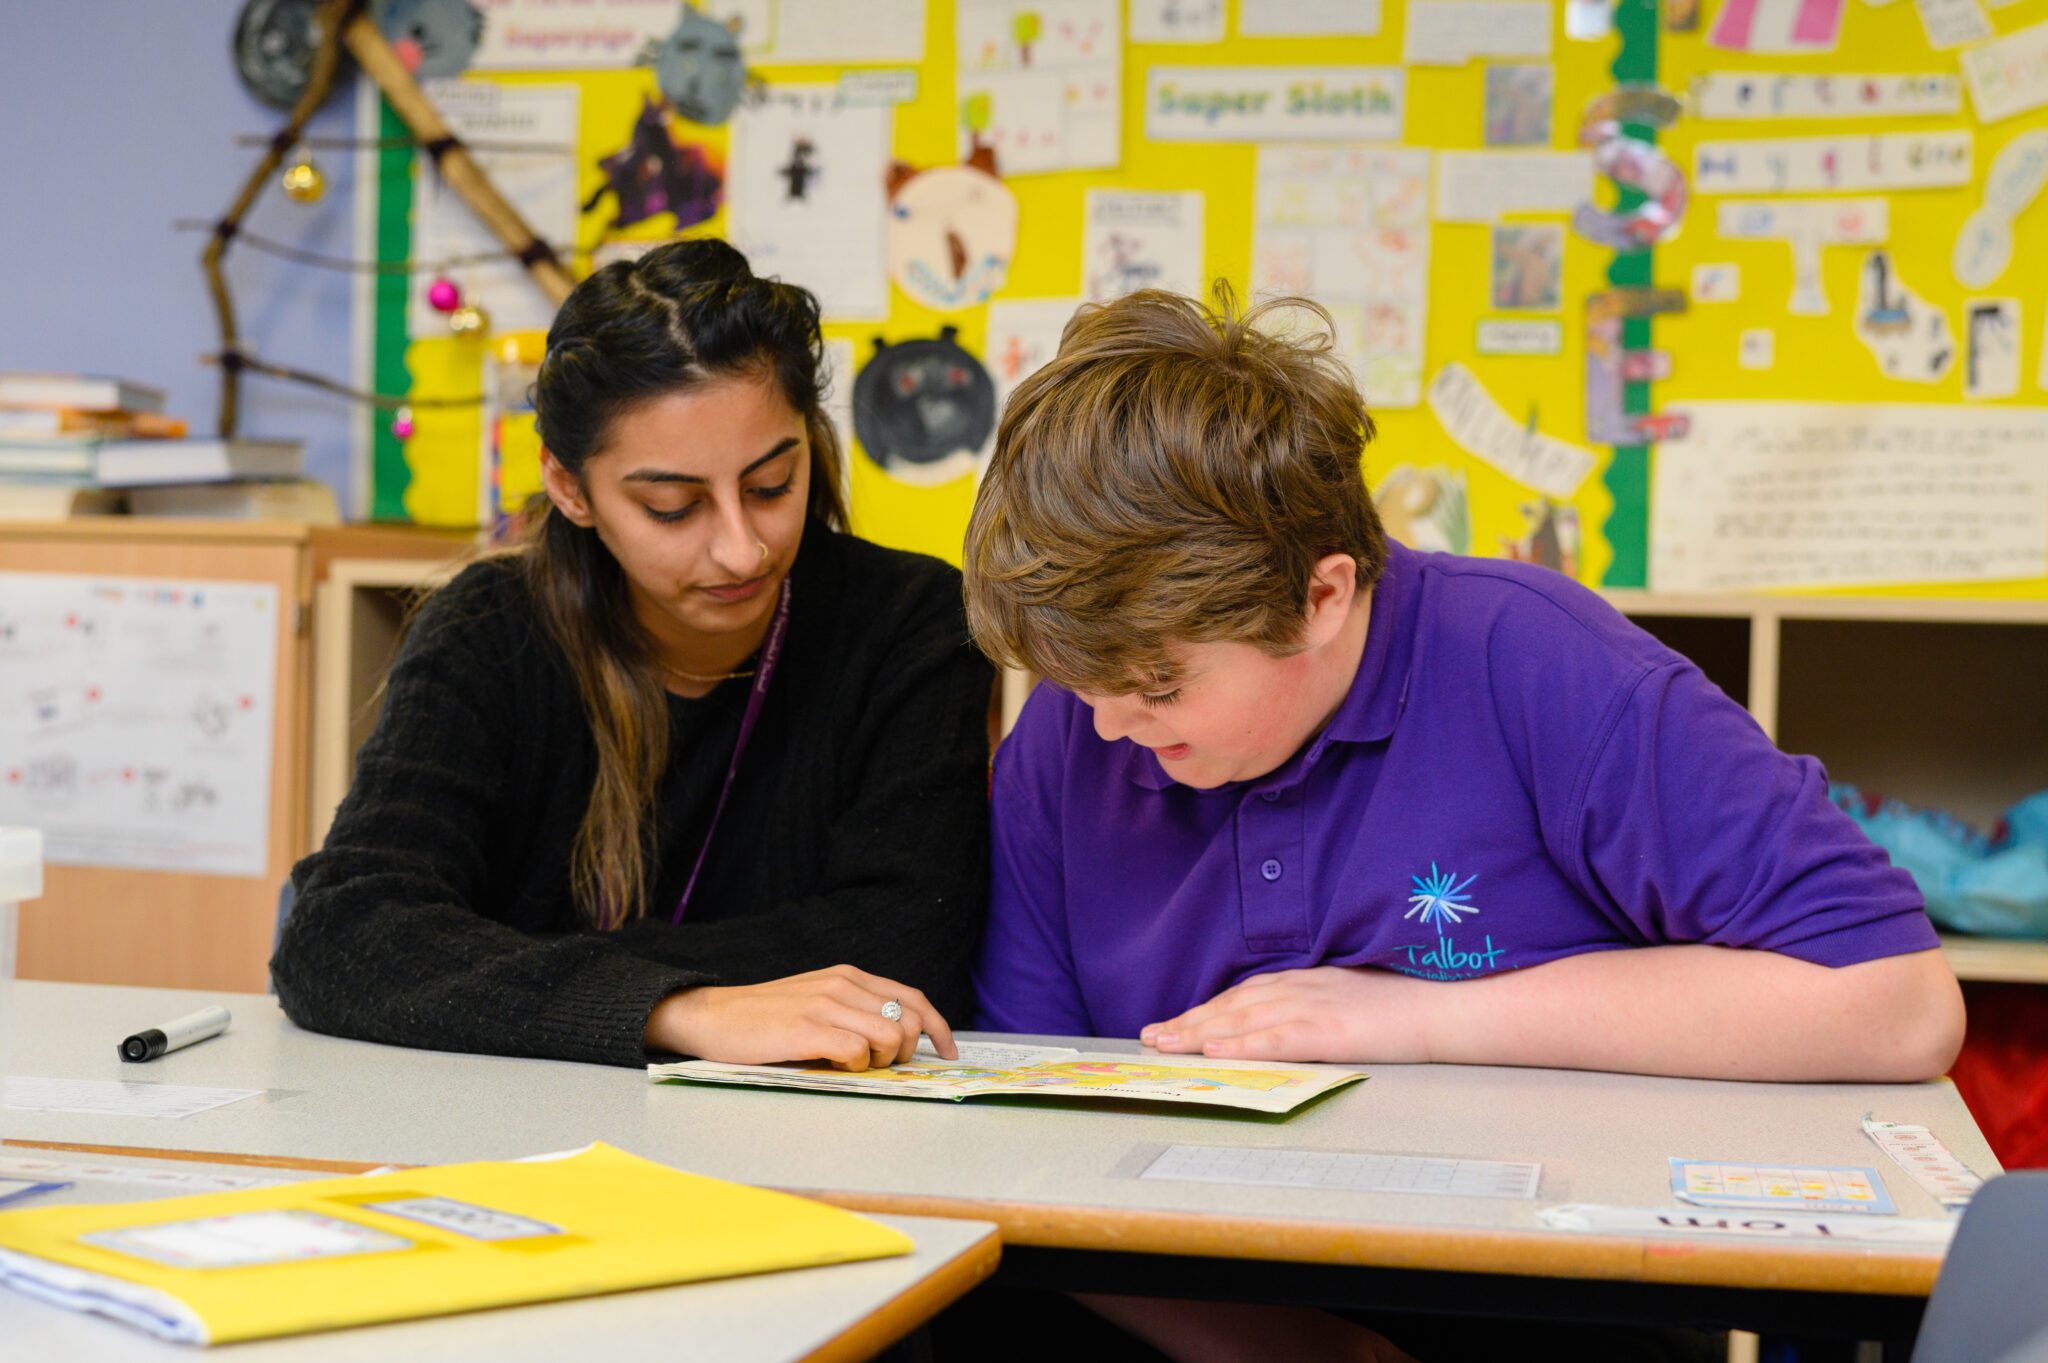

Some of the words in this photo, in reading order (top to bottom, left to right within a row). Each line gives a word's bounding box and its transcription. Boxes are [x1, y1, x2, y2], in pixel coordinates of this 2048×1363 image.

[1157, 81, 1268, 125] Super
[1286, 78, 1392, 118] Sloth
[1392, 935, 1504, 969] Talbot
